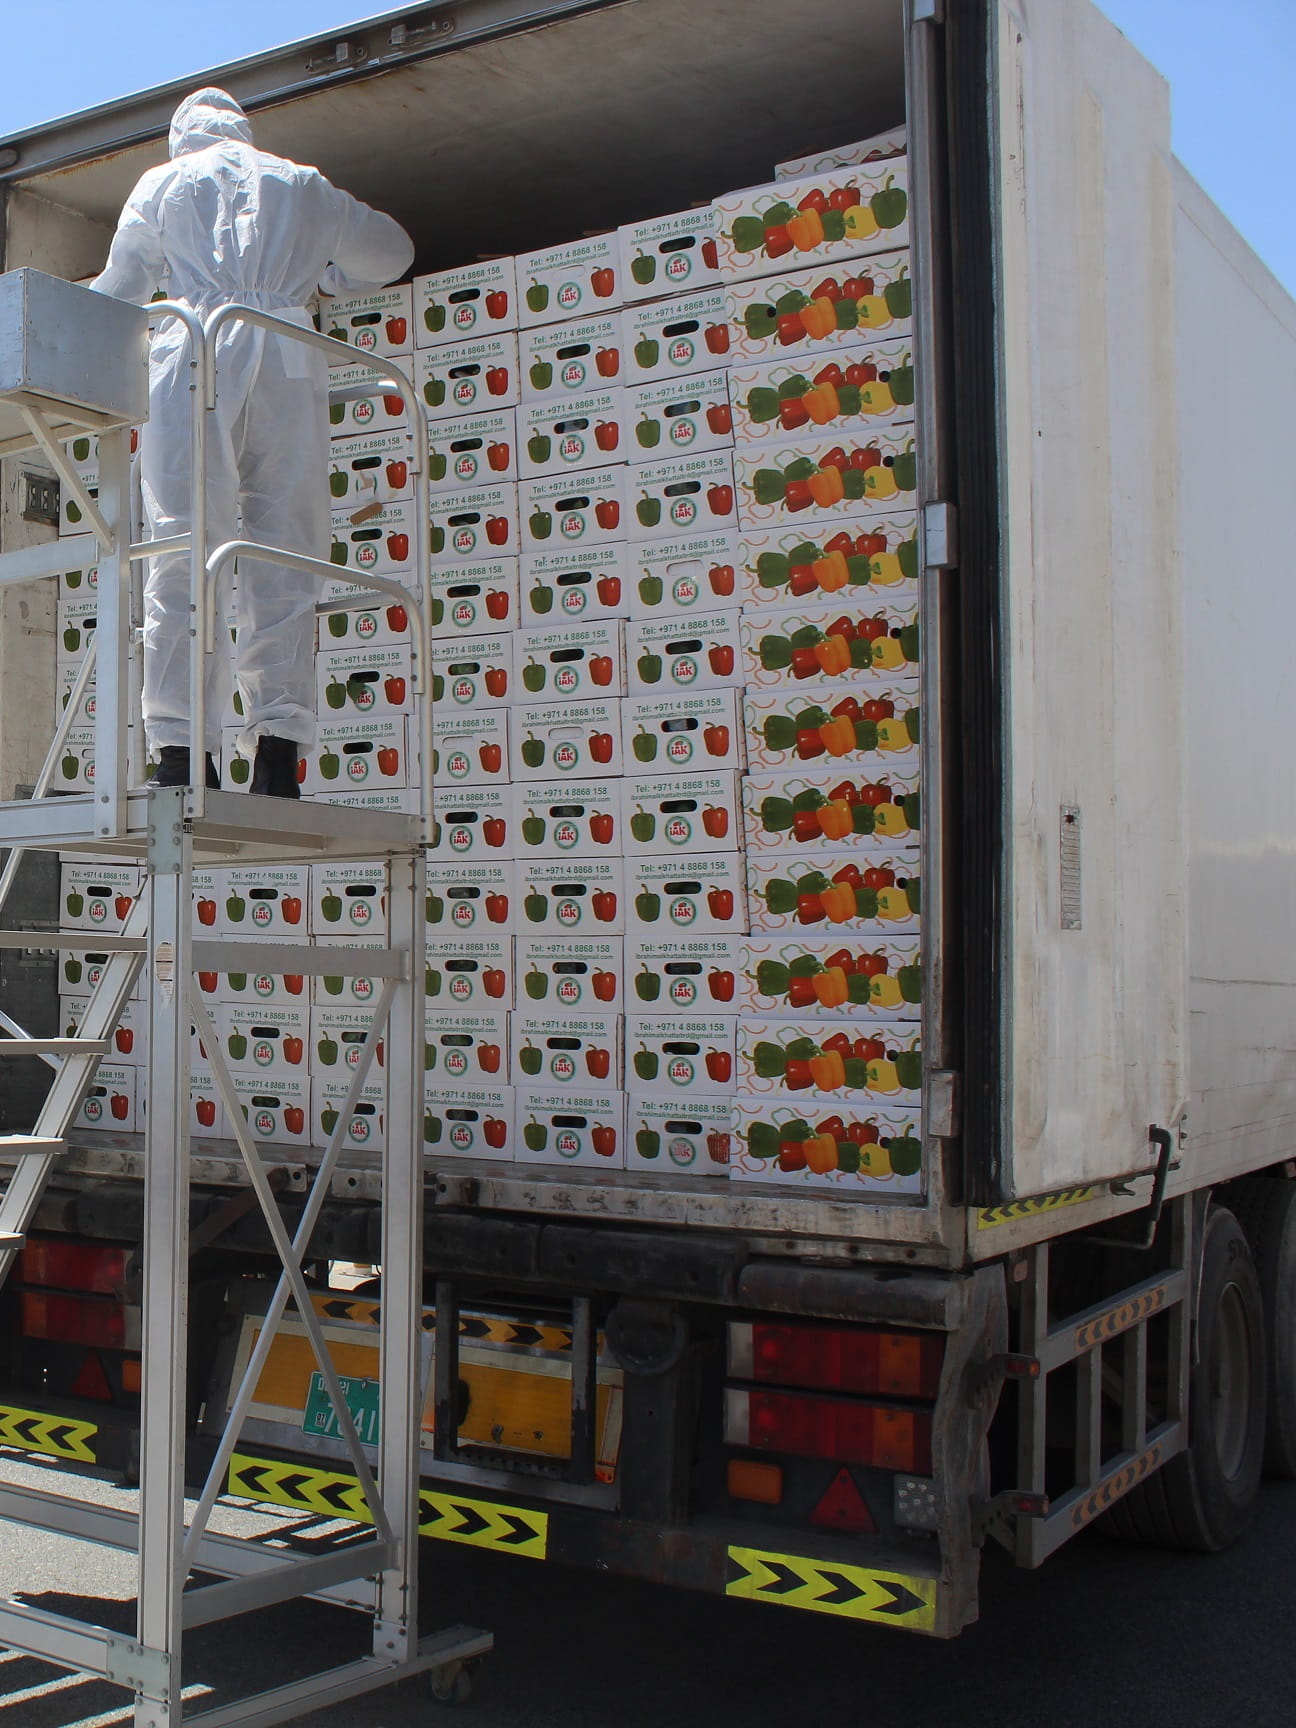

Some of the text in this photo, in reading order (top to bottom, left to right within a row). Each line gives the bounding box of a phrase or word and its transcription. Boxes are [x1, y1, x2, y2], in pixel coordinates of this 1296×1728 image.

[529, 258, 544, 267] Tel:
[545, 253, 563, 262] +971
[572, 247, 590, 257] 8868
[593, 243, 607, 251] 158
[442, 275, 459, 284] +971
[467, 269, 484, 279] 8868
[487, 266, 500, 275] 158
[638, 313, 652, 321] Tel:
[655, 308, 674, 316] +971
[684, 301, 703, 311] 8868
[707, 297, 721, 306] 158
[533, 486, 546, 494] Tel:
[549, 482, 566, 490] +971
[576, 477, 595, 486] 8868
[598, 474, 612, 483] 158
[642, 549, 656, 558] Tel:
[659, 545, 678, 554] +971
[688, 540, 708, 550] 8868
[711, 538, 726, 547] 158
[368, 653, 385, 662] 8868
[387, 652, 400, 660] 158
[687, 862, 707, 871] 8868
[710, 861, 725, 870] 158
[530, 944, 544, 952] Tel:
[656, 1023, 675, 1031] +971
[686, 1023, 706, 1031] 8868
[709, 1023, 724, 1031] 158
